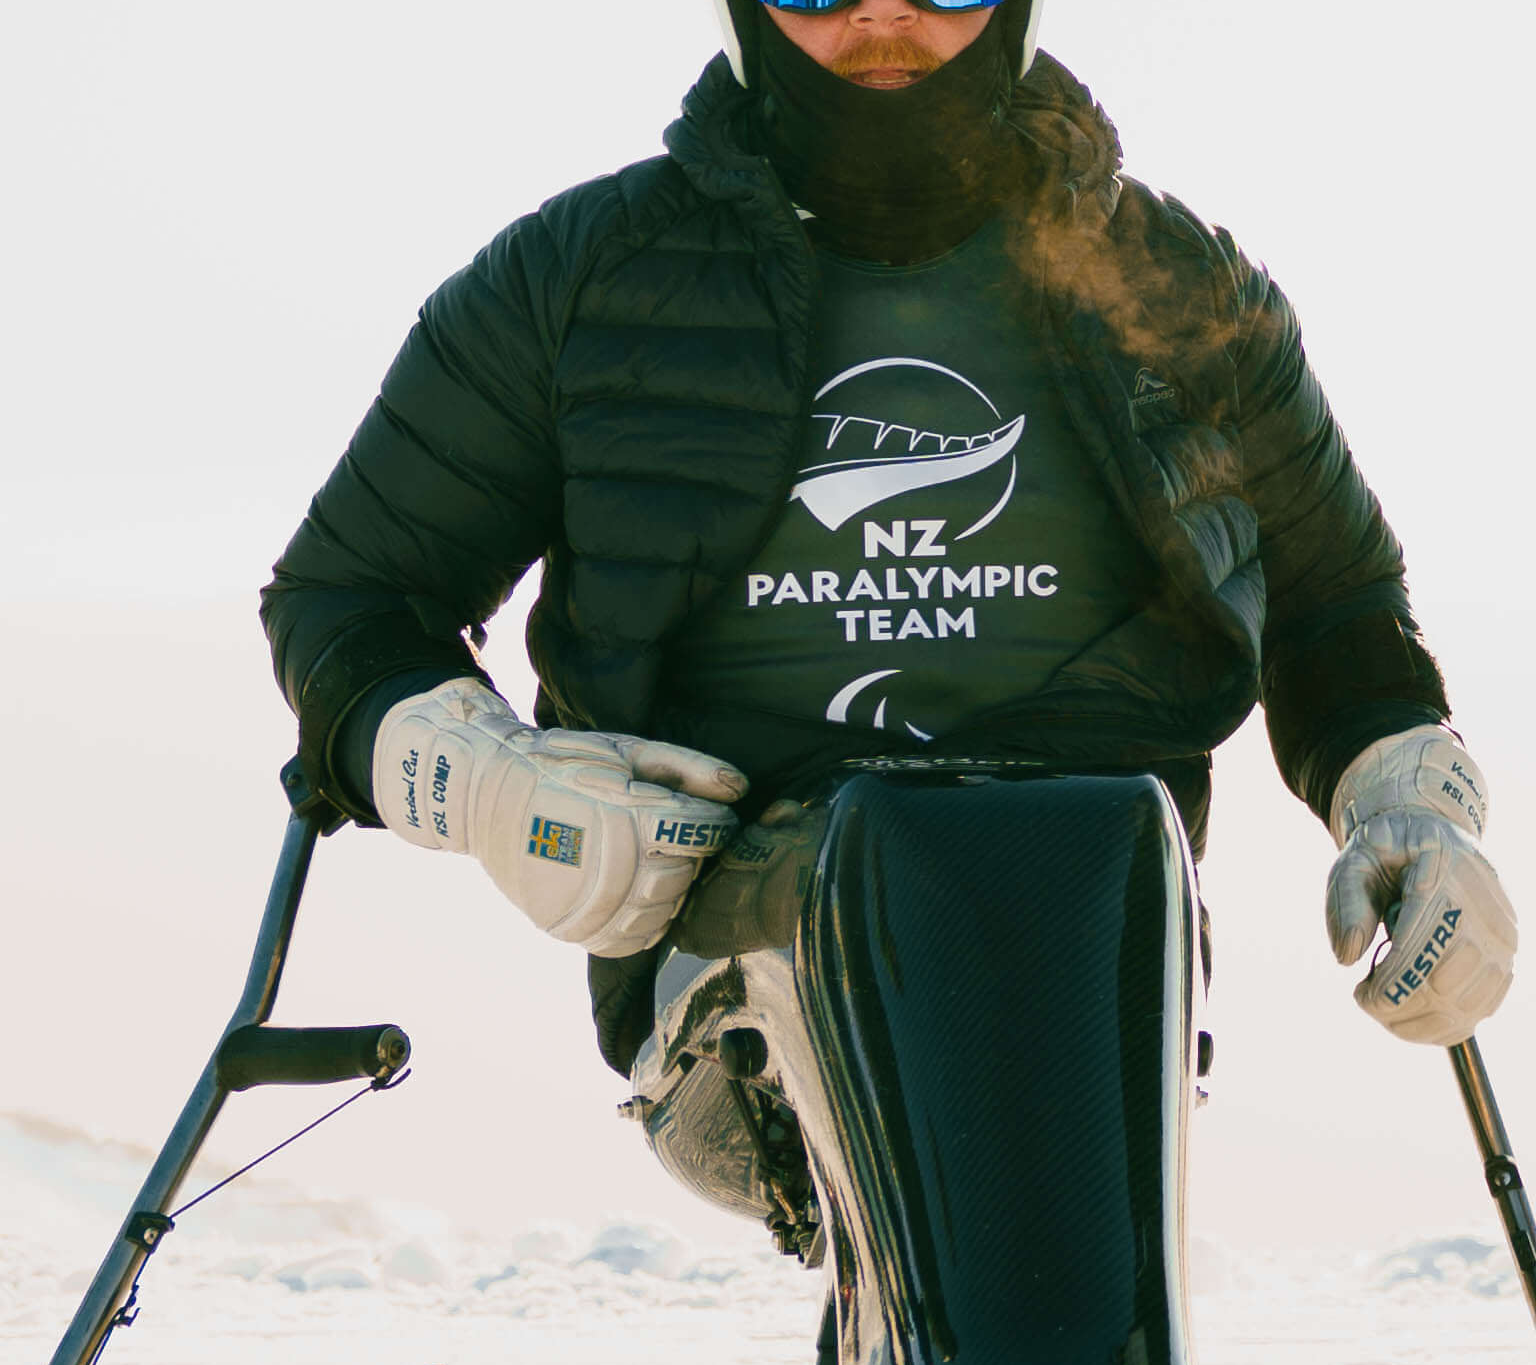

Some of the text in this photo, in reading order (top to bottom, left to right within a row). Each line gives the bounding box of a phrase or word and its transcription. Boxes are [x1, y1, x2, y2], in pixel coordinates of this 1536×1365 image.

[863, 519, 947, 559] NZ
[746, 564, 1059, 607] PARALYMPIC
[835, 607, 976, 642] TEAM
[432, 754, 452, 804] COMP
[1442, 780, 1465, 807] RSL
[1384, 908, 1462, 1006] HESTRA
